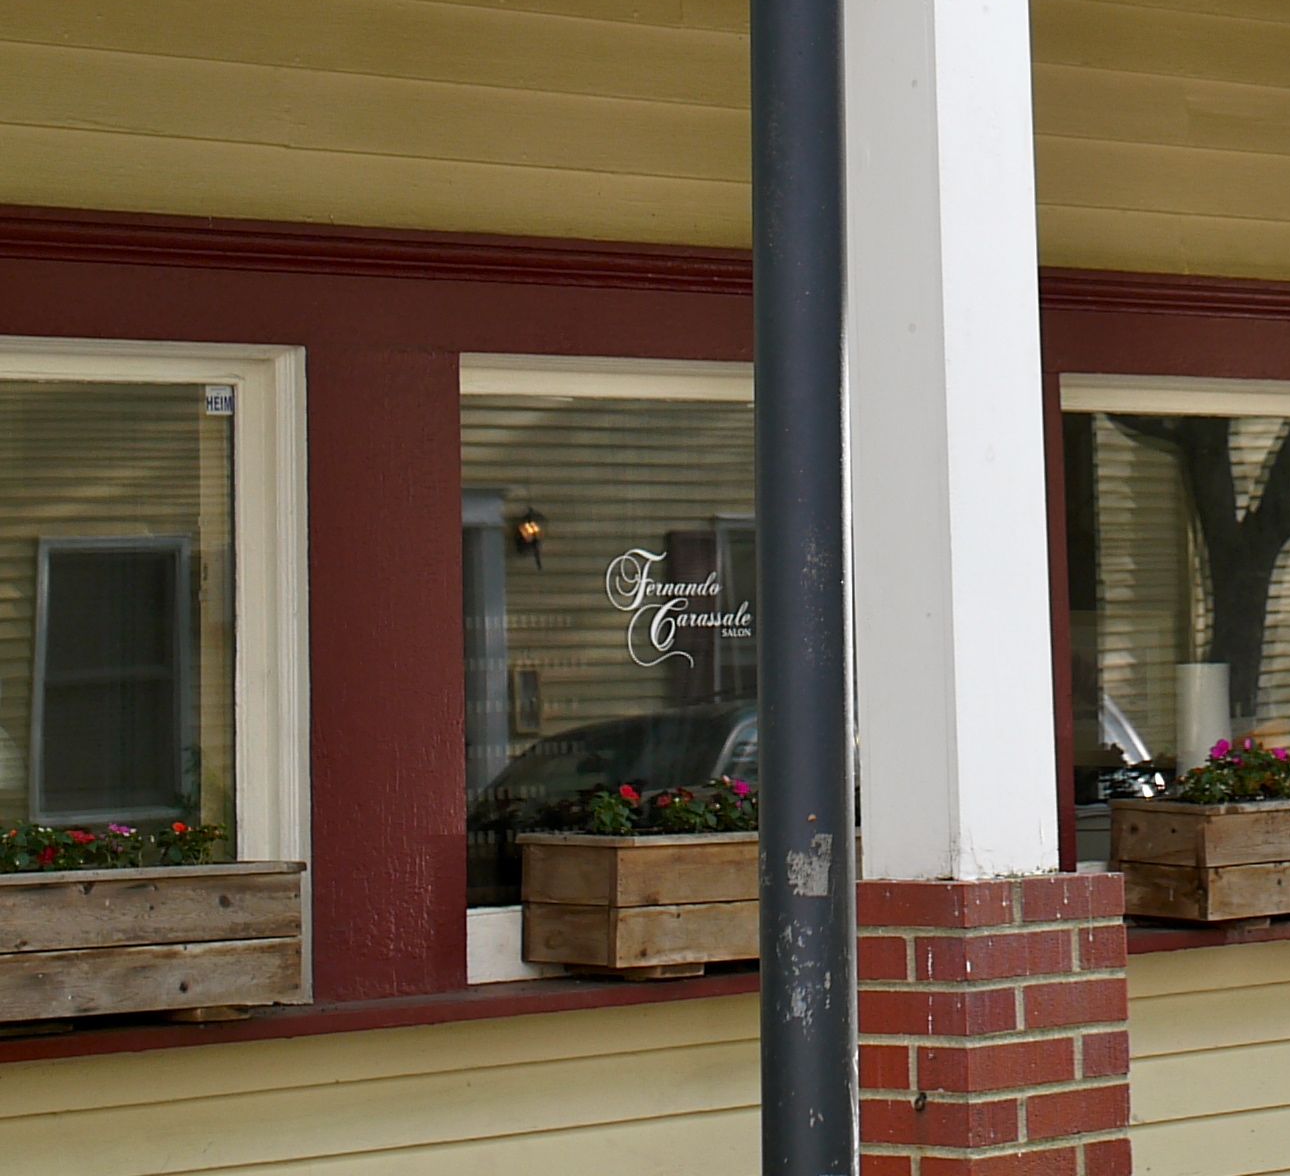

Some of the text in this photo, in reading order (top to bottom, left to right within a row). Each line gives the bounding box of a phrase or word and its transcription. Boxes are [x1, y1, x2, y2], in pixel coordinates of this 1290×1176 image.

[606, 548, 721, 611] Fernando
[628, 598, 752, 668] Carassale
[721, 628, 752, 638] SALON
